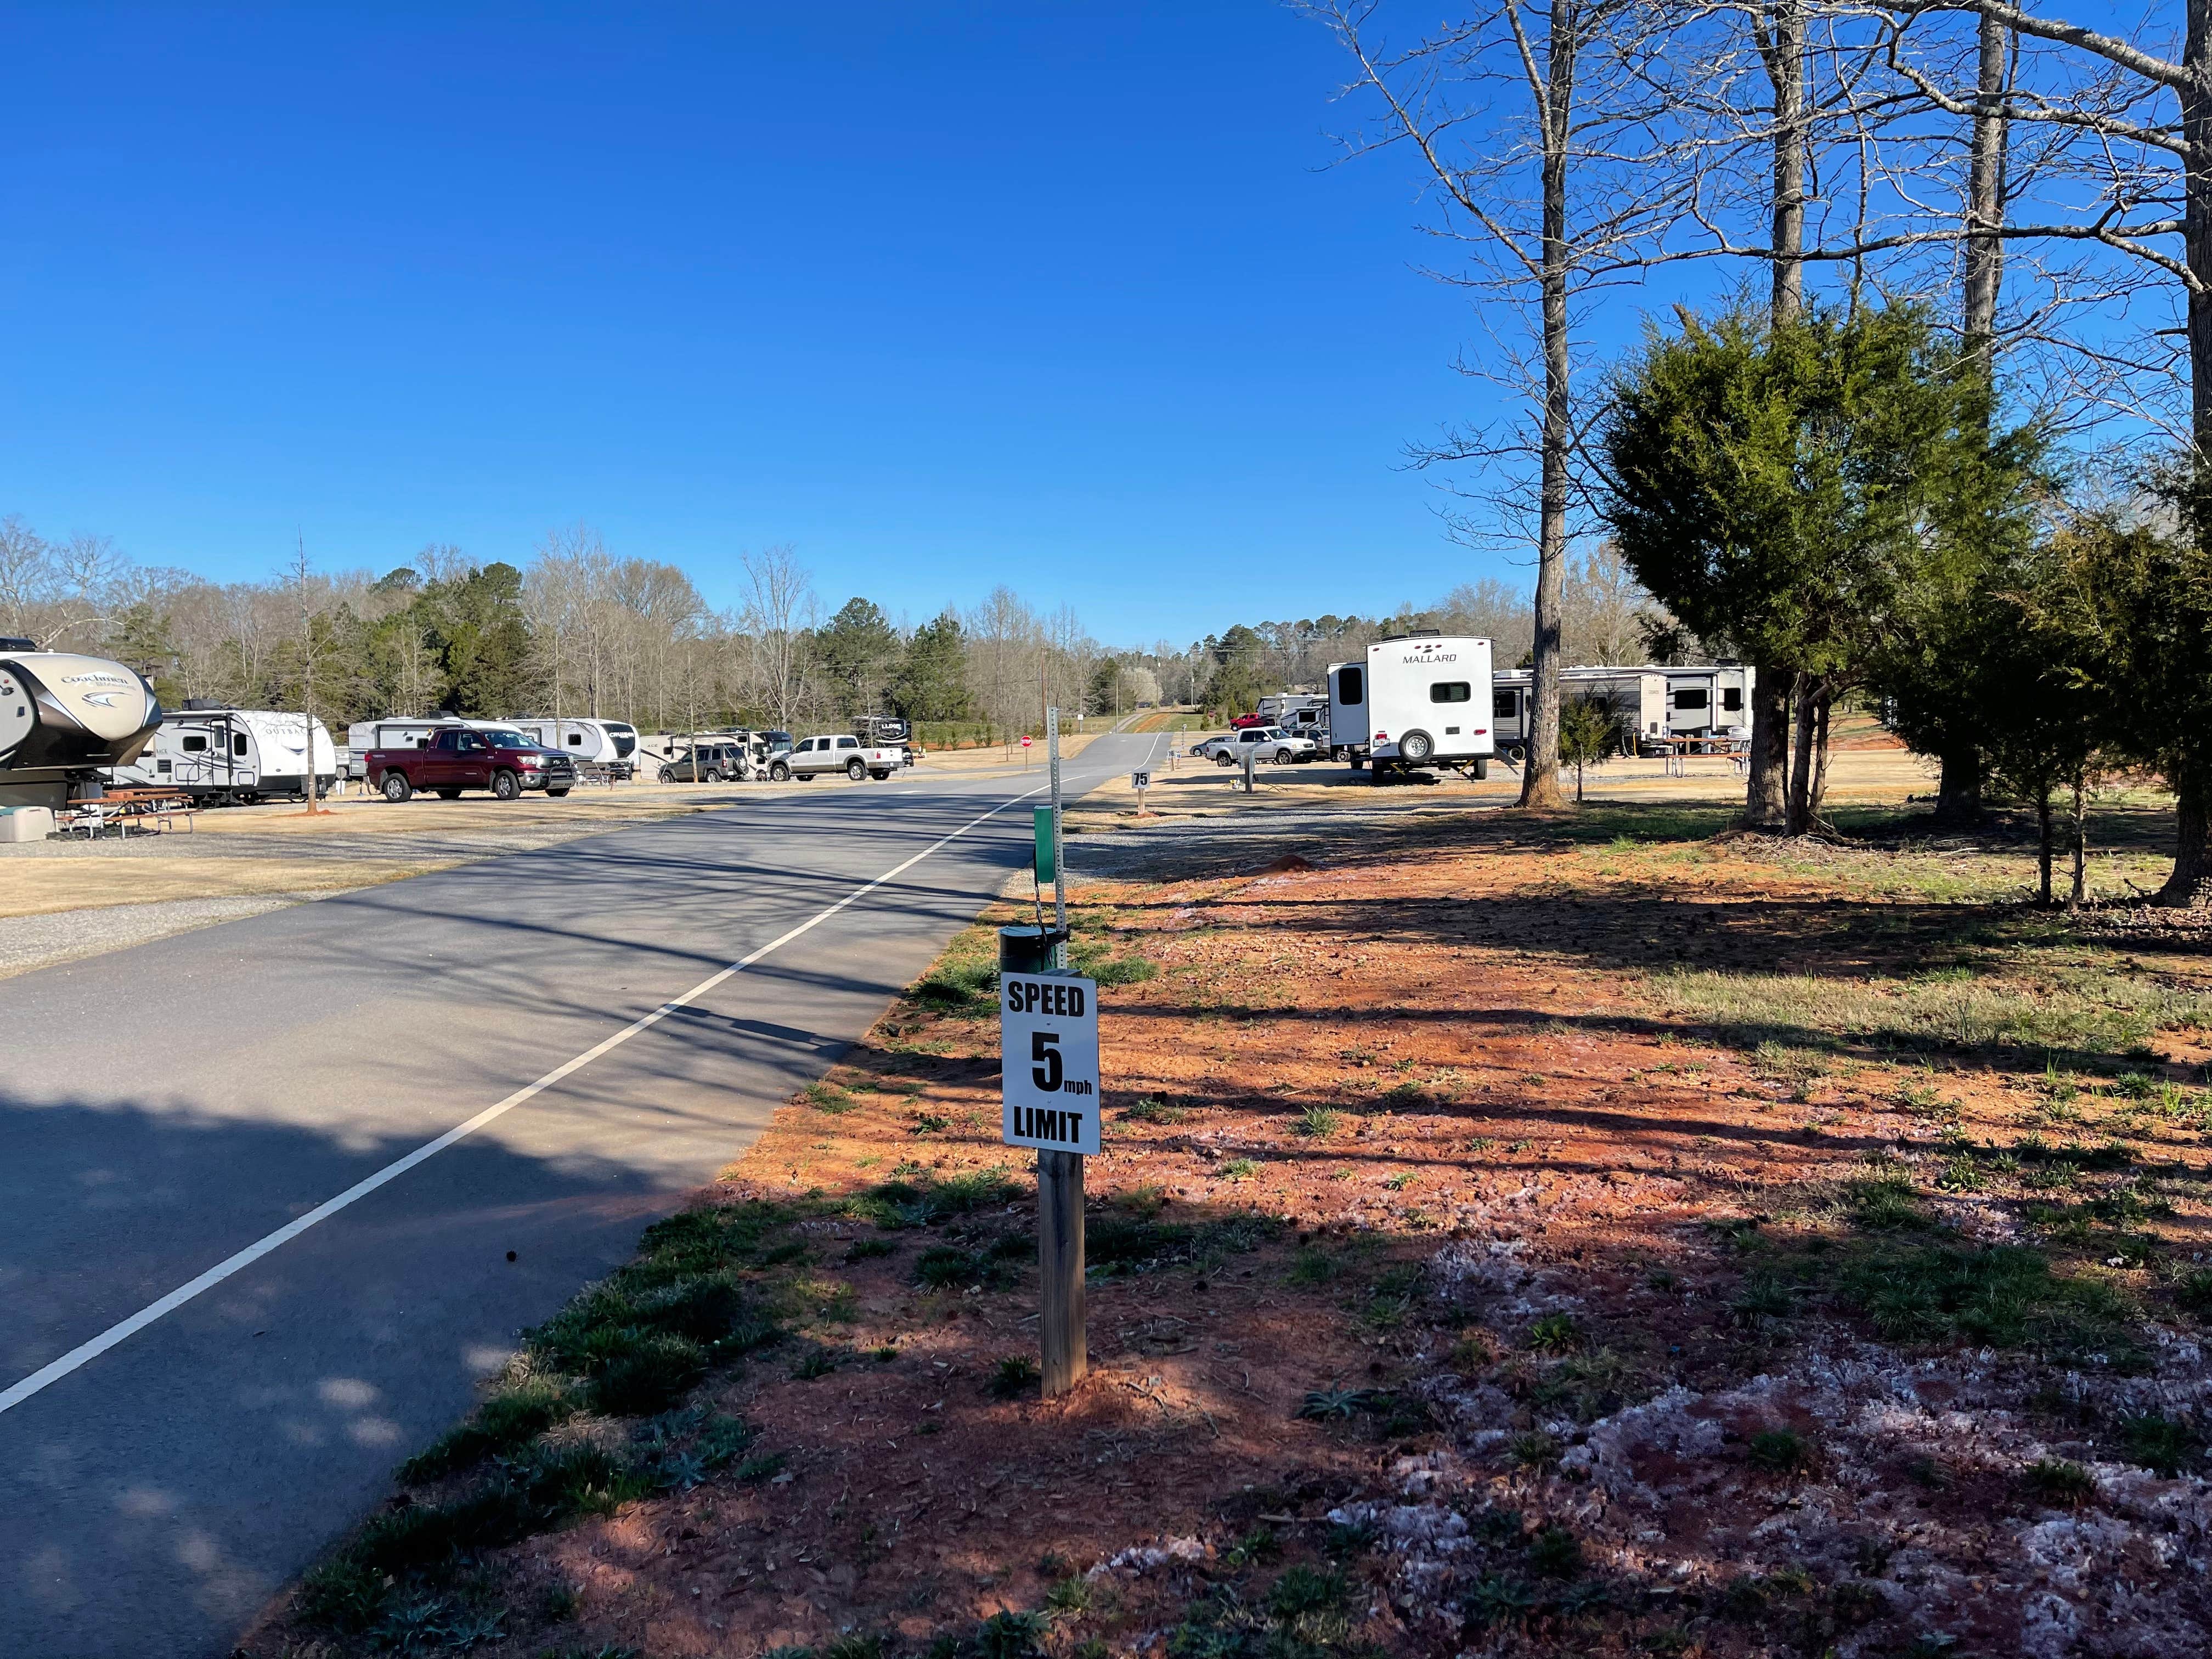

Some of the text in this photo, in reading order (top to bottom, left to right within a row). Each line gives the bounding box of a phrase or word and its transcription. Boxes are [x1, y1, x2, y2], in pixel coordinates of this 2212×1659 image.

[1403, 654, 1457, 663] MALLARD
[1133, 772, 1148, 786] 75
[1008, 980, 1085, 1017] SPEED
[1032, 1031, 1092, 1095] 5 mph
[1014, 1105, 1083, 1144] LIMIT
